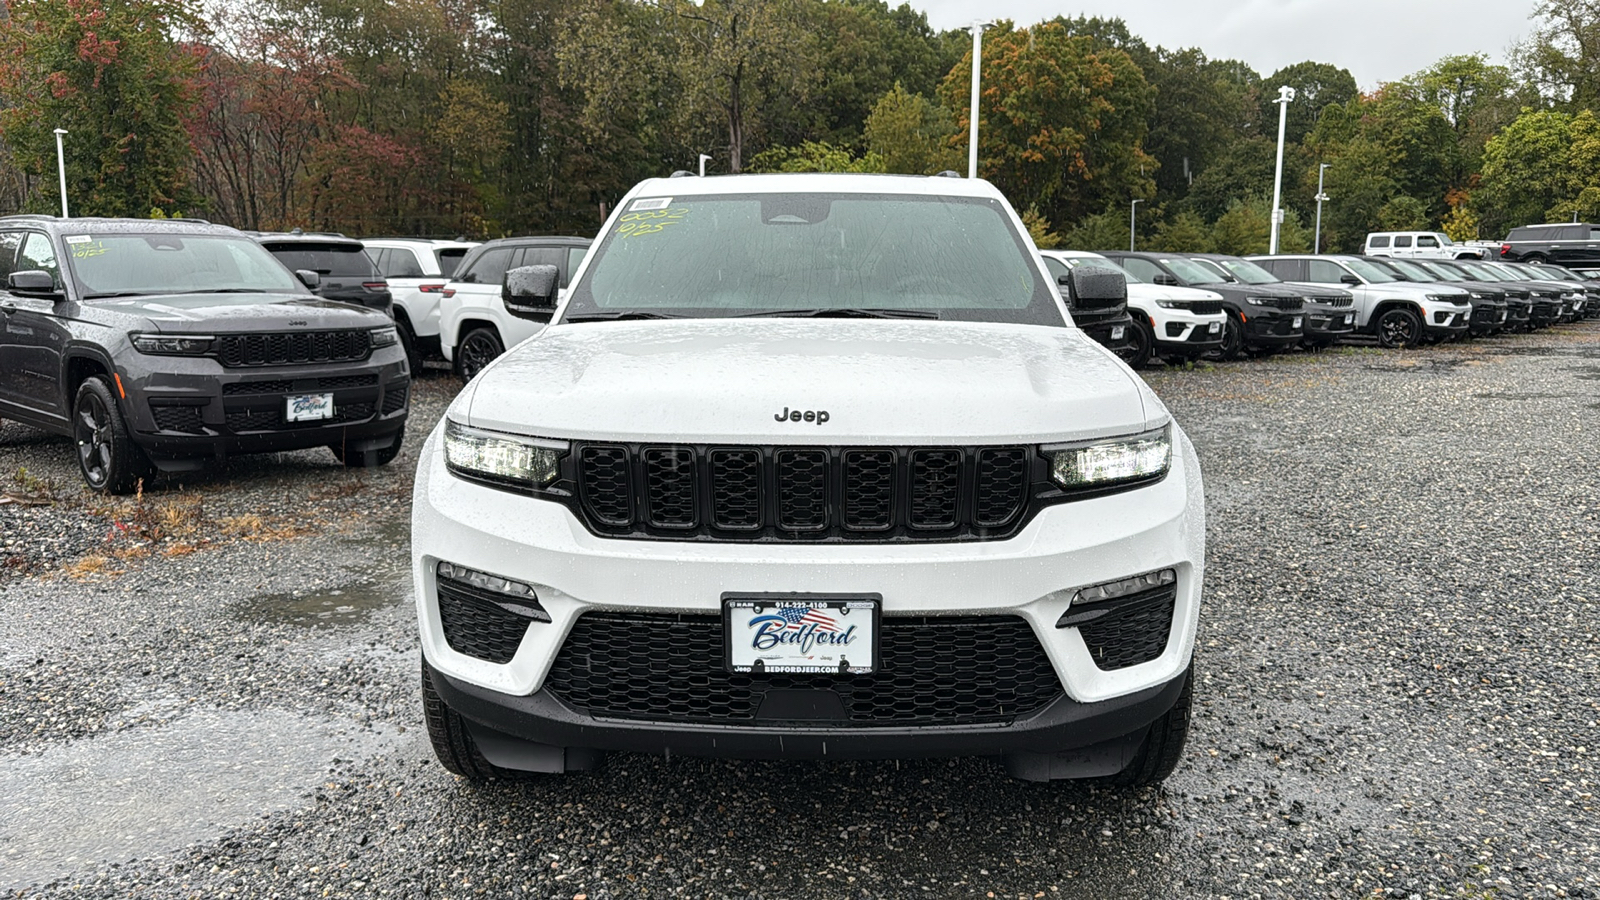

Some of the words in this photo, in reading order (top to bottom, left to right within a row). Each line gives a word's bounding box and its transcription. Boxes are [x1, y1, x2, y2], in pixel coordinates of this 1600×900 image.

[615, 221, 679, 239] 10/25
[73, 247, 112, 260] 10/25
[292, 400, 328, 415] Bedford
[774, 407, 830, 425] Jeep
[748, 614, 857, 654] Bedford
